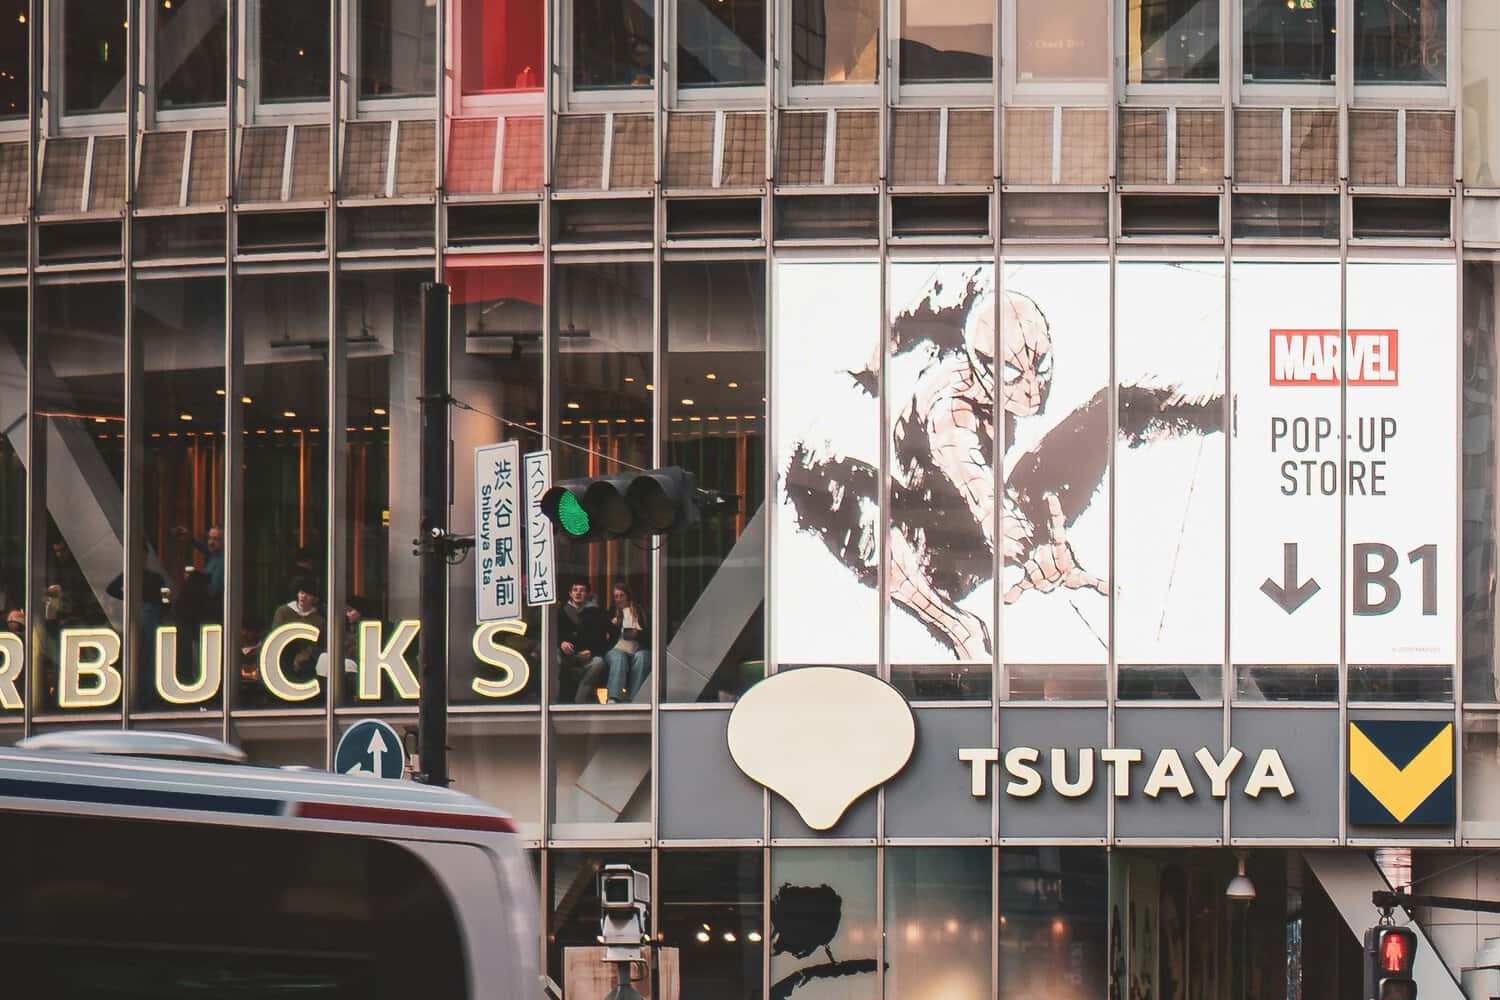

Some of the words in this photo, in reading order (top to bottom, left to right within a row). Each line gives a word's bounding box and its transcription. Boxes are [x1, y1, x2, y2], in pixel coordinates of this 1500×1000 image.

[1273, 333, 1397, 382] MARVEL
[1271, 416, 1397, 453] POP-UP
[1280, 460, 1387, 496] STORE
[482, 485, 492, 551] Shibuya
[494, 459, 514, 606] 渋谷駅前
[530, 460, 549, 599] スクランブル式
[482, 558, 493, 591] Sta.
[1353, 542, 1438, 616] B1
[958, 746, 1296, 798] TSUTAYA
